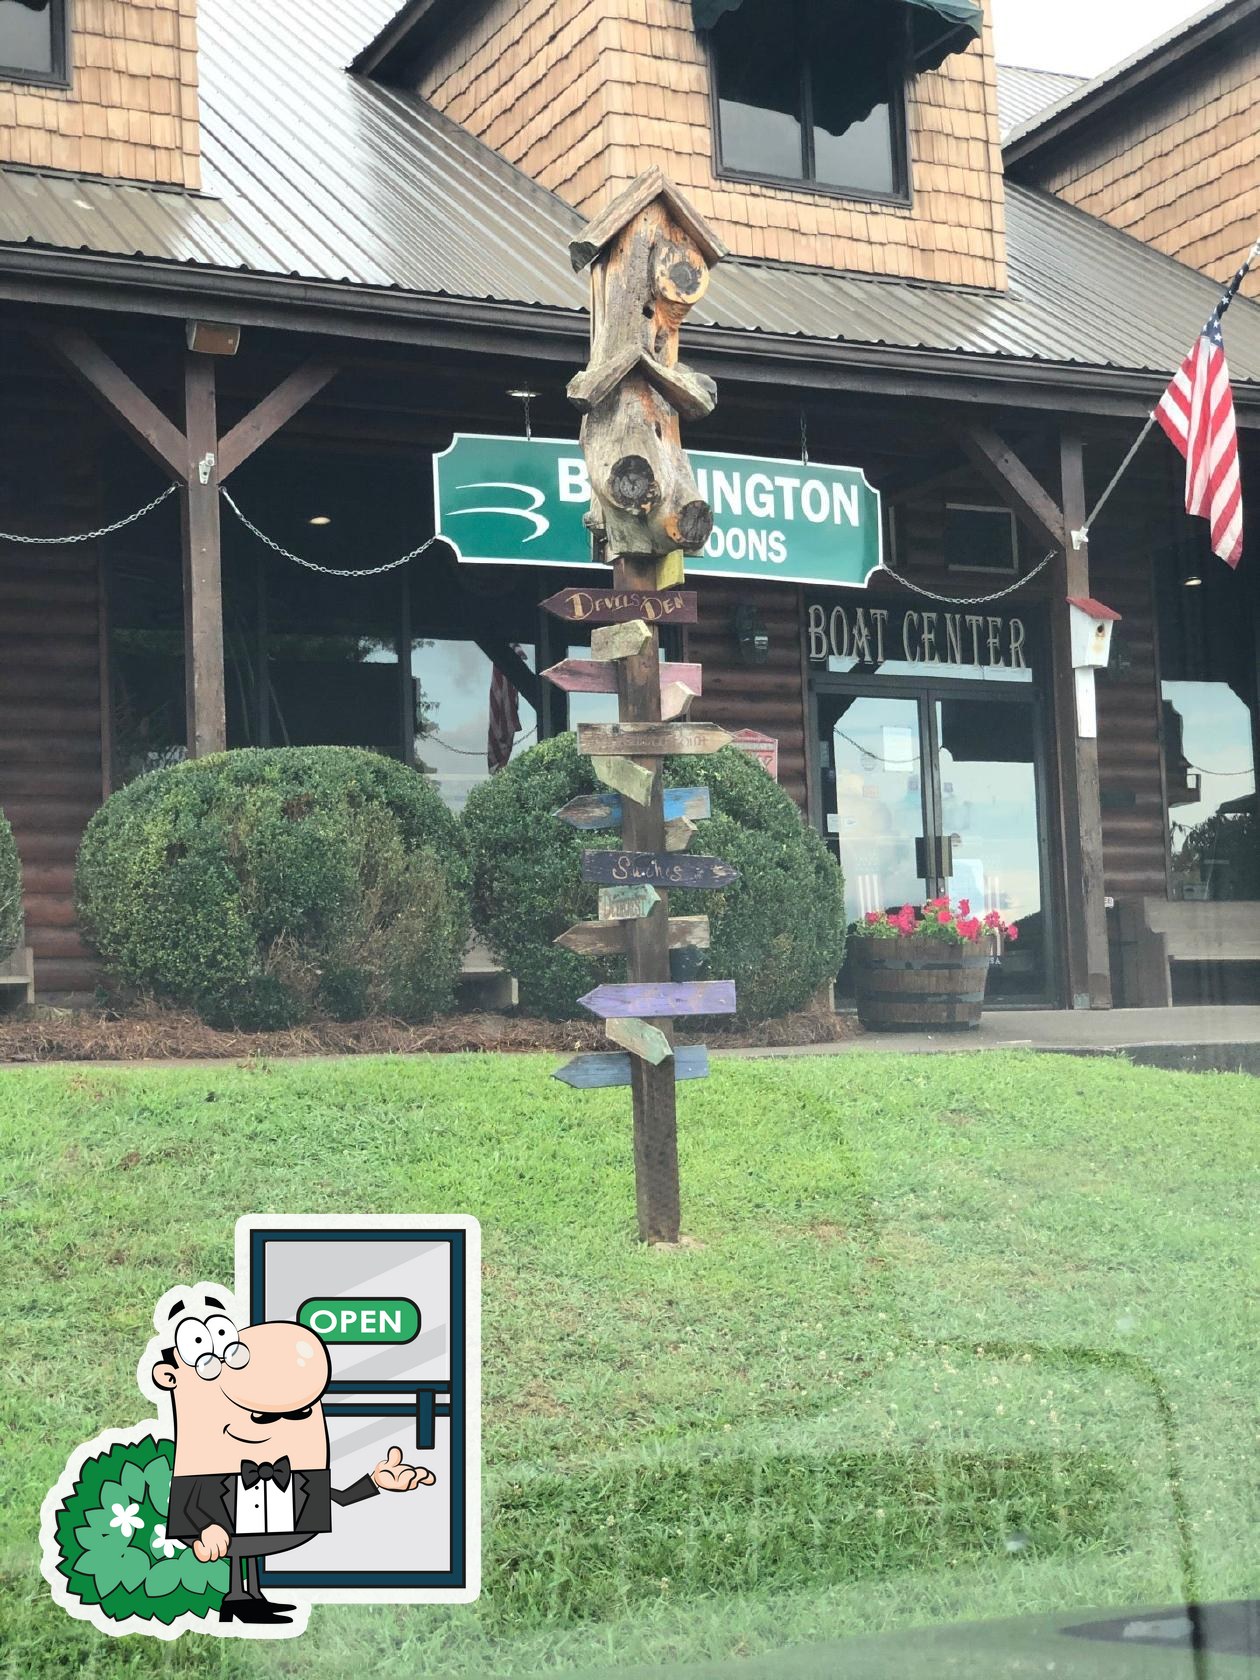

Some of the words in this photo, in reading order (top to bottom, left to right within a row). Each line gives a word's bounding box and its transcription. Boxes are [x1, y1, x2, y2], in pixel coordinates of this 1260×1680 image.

[558, 457, 859, 527] BINGTON
[808, 604, 888, 664] BOAT
[902, 610, 1026, 671] CENTER
